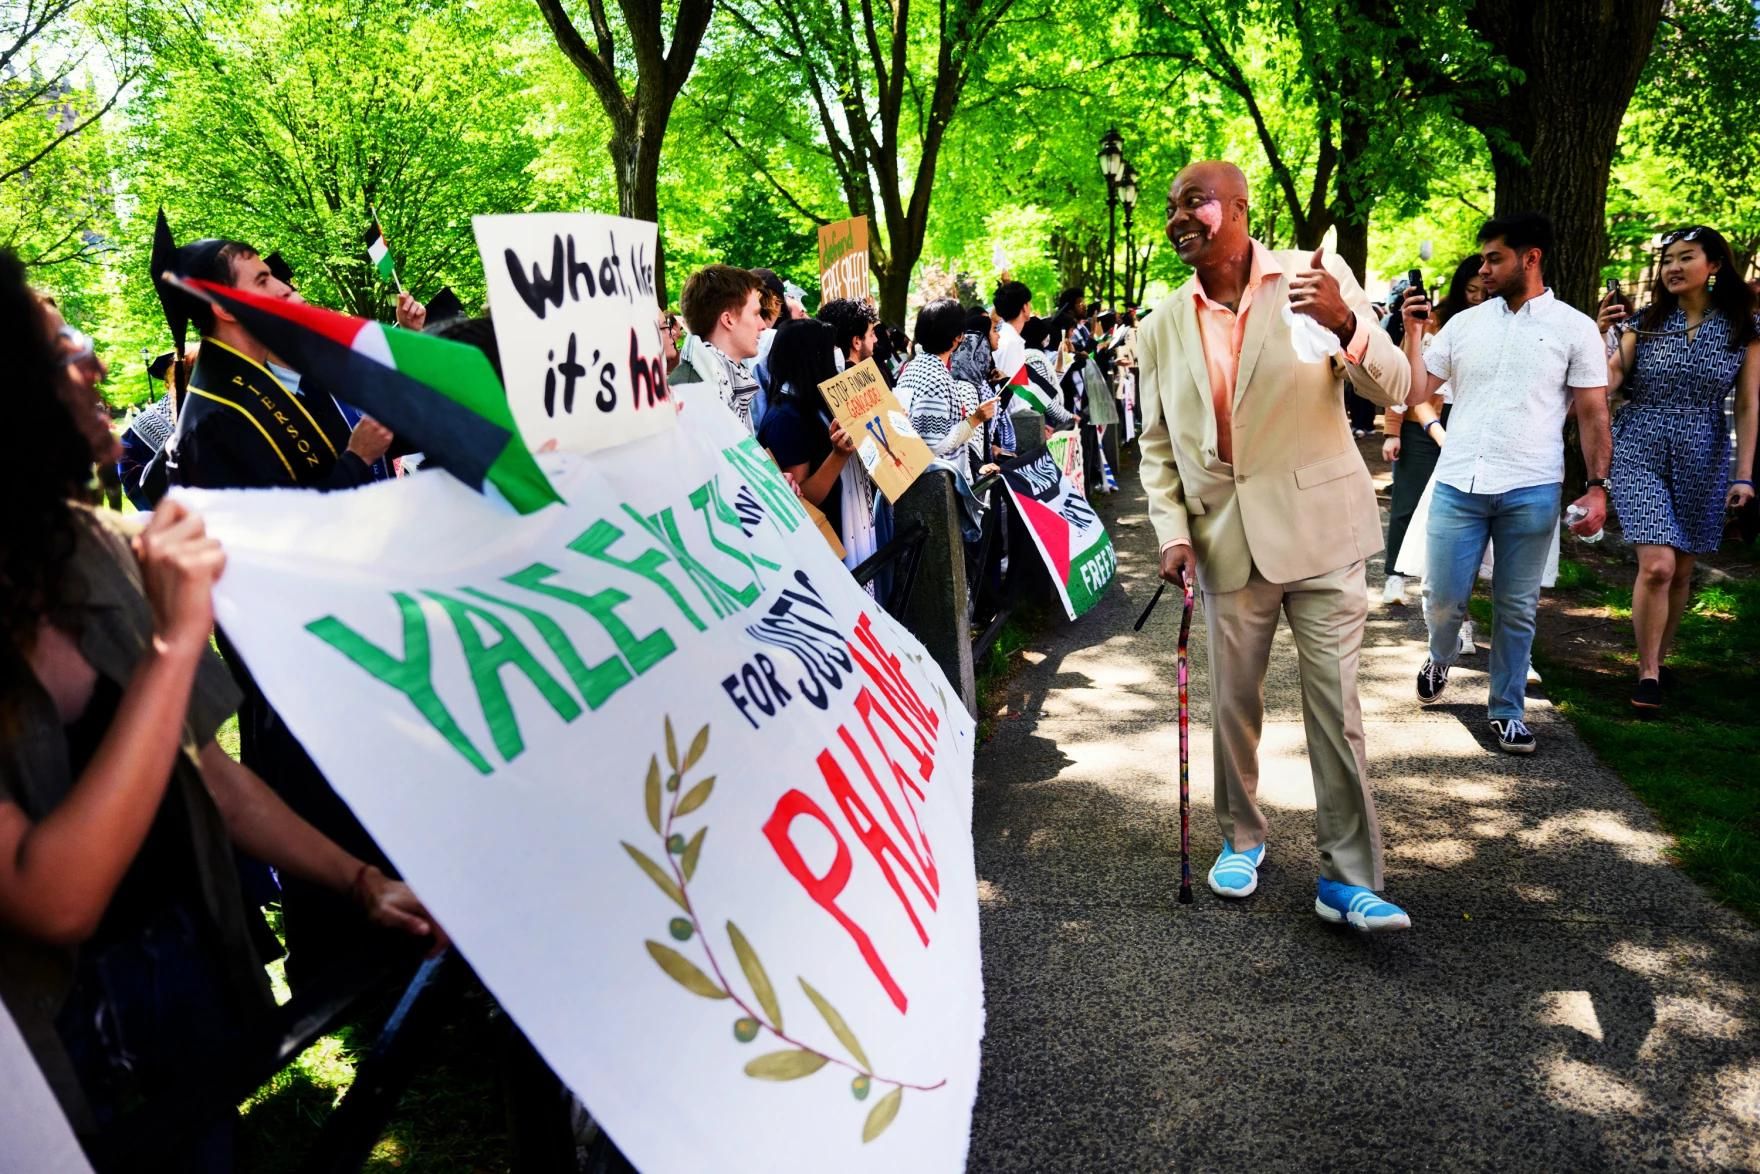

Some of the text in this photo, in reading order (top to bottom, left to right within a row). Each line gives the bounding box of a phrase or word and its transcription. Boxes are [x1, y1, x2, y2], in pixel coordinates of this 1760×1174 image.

[544, 332, 617, 418] it's
[827, 367, 876, 408] STOP FUNDING
[232, 375, 320, 469] PIERSON
[1080, 549, 1111, 596] FREE
[303, 562, 678, 776] YALE
[721, 653, 792, 730] FOR
